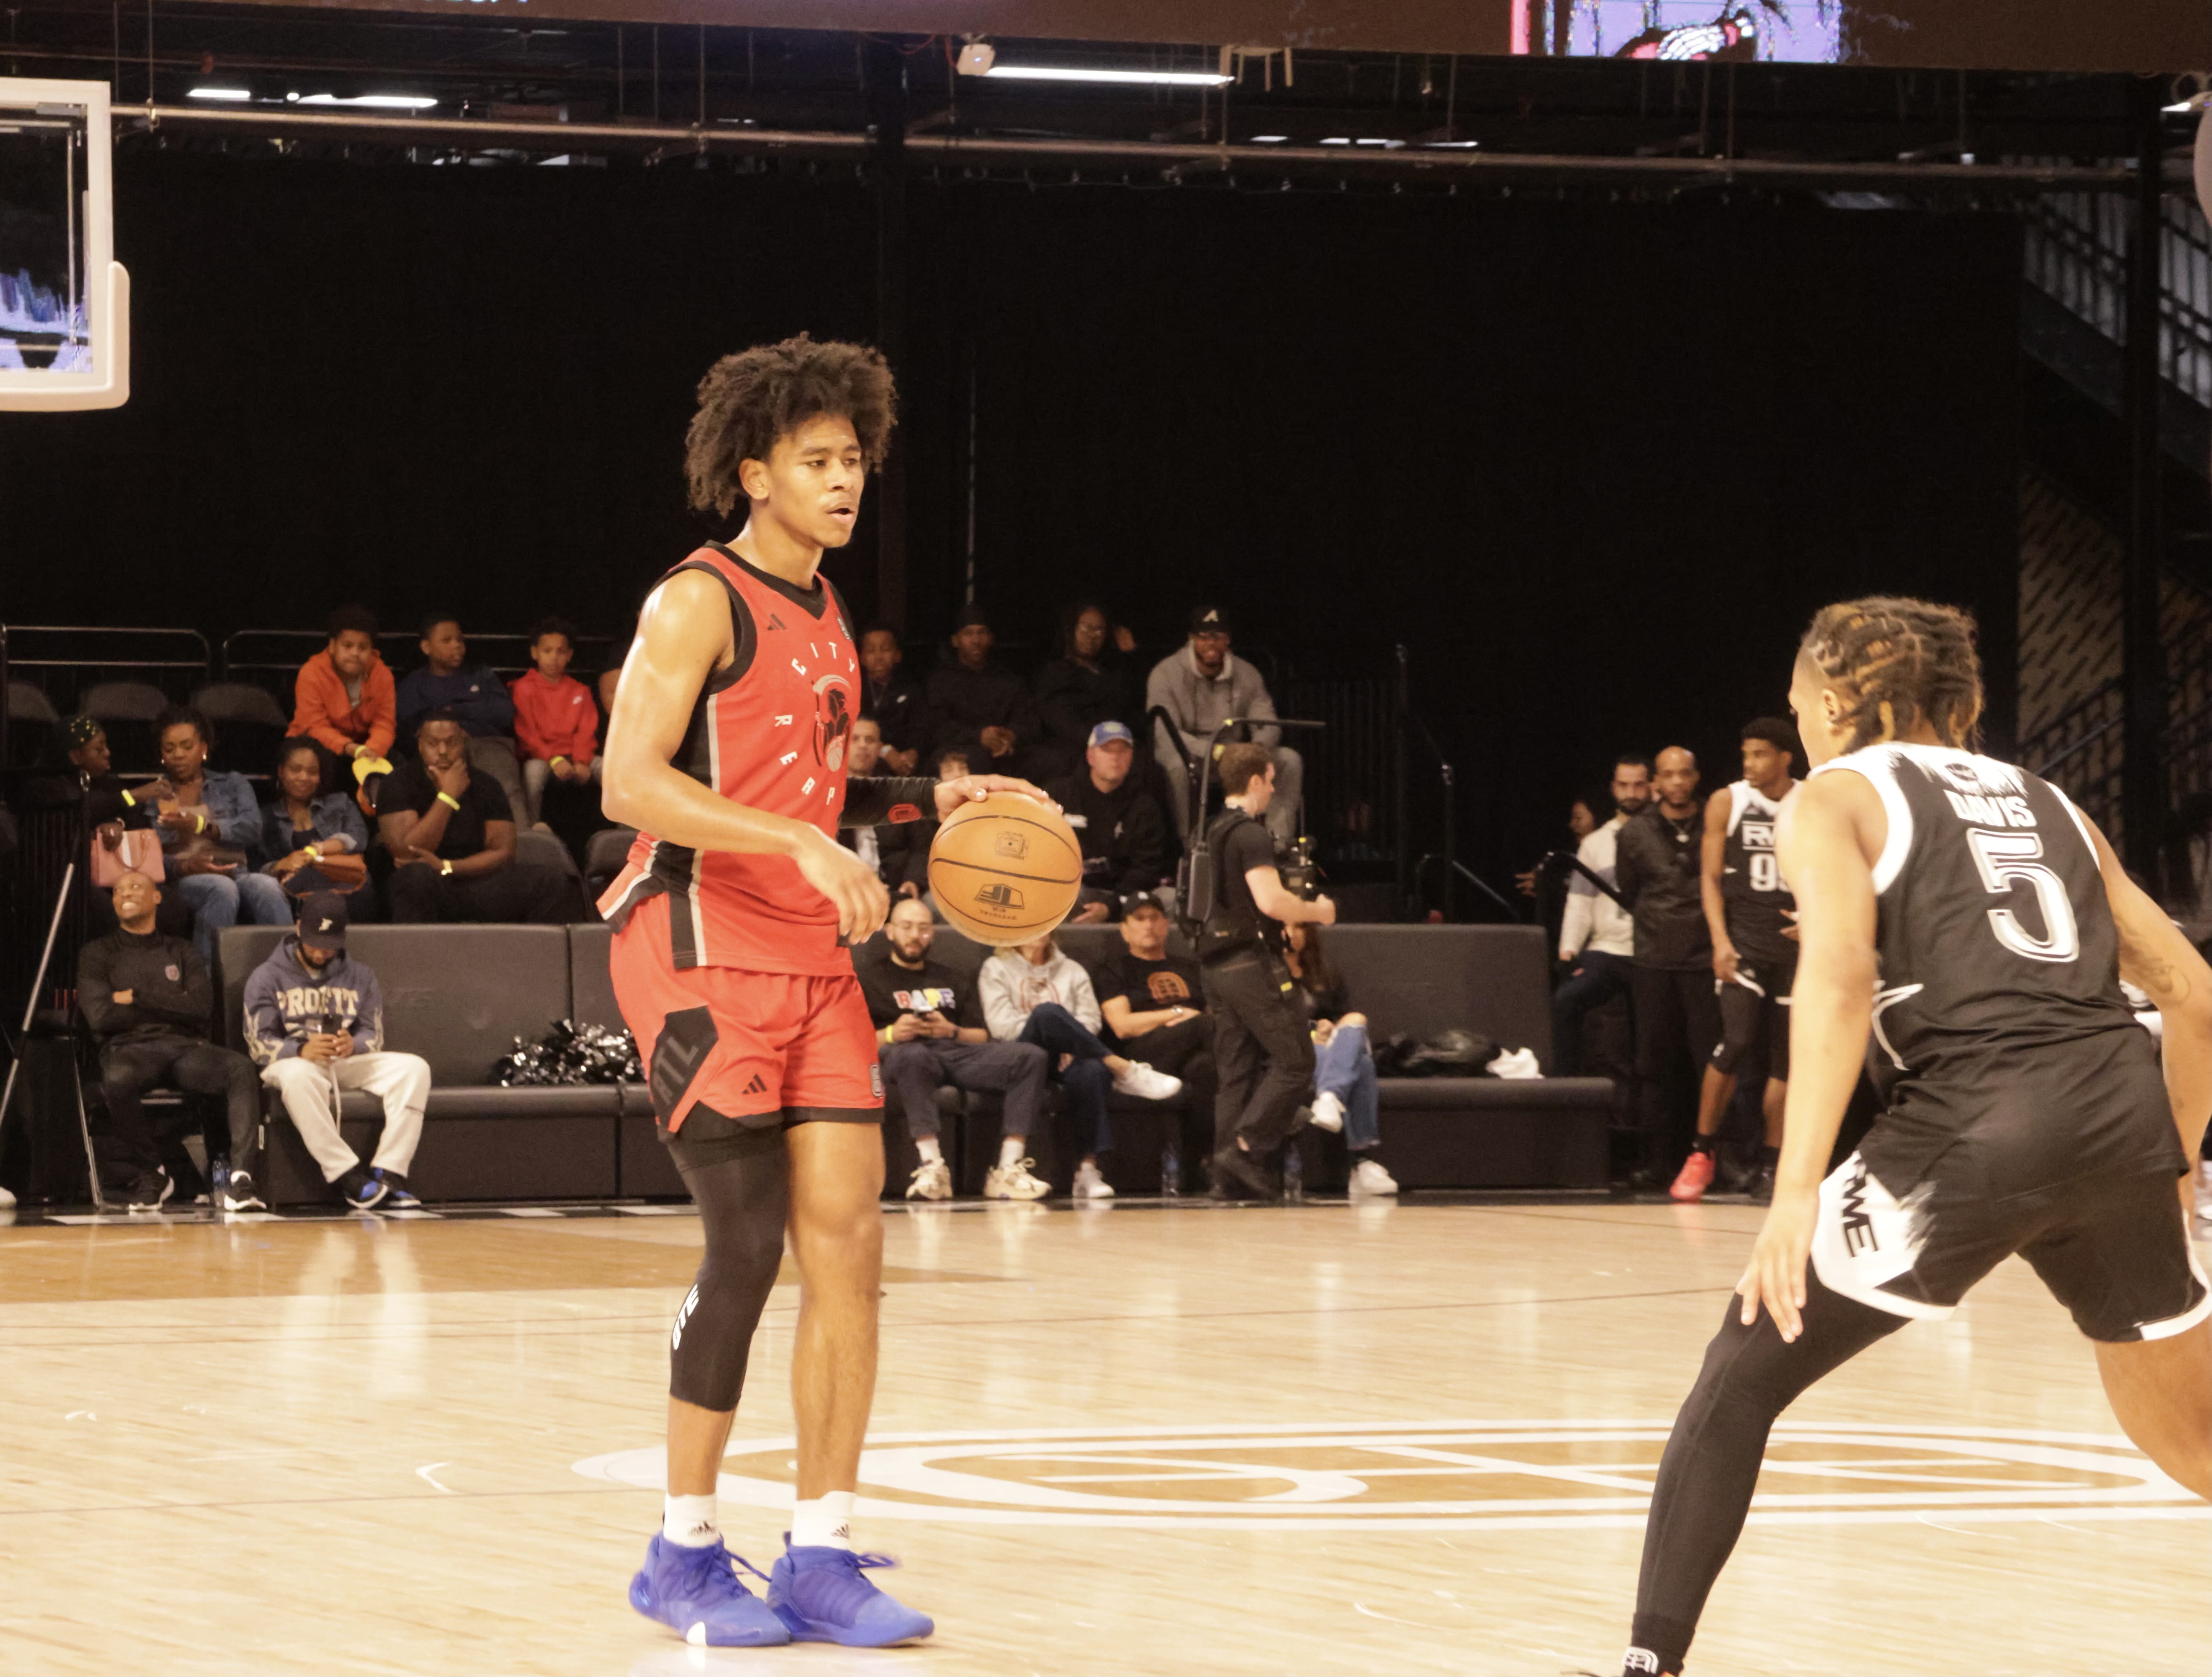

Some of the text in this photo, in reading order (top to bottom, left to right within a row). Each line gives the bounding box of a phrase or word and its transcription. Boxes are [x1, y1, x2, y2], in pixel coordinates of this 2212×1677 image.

[791, 641, 855, 676] CITY
[1943, 789, 2038, 827] DAVIS
[1966, 827, 2080, 963] 5
